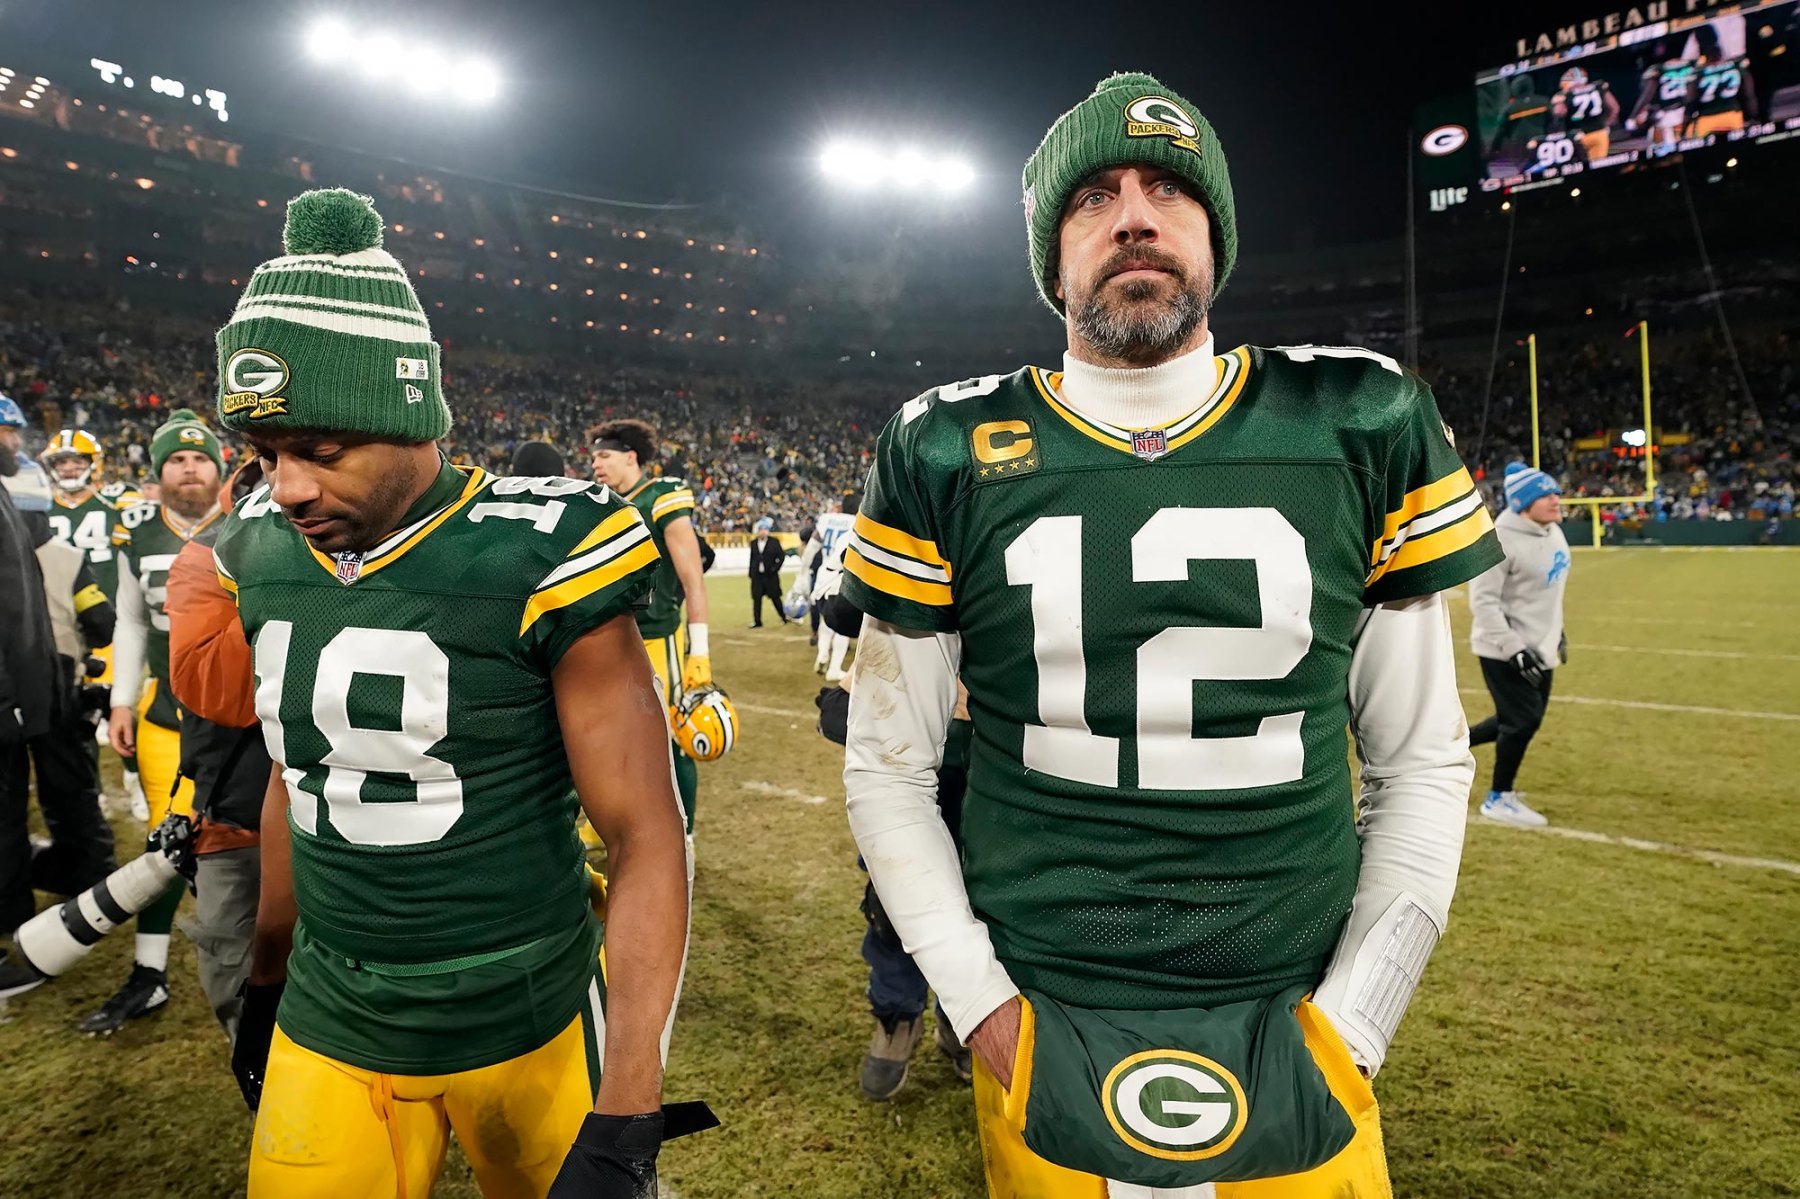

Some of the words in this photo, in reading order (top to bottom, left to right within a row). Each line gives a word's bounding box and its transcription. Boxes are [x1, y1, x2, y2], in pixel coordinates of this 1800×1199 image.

[1516, 1, 1668, 58] LAMBEAU
[1130, 124, 1179, 136] PACKERS
[1537, 139, 1574, 166] 90
[259, 400, 278, 413] NFC
[972, 420, 1033, 464] C
[1137, 439, 1162, 452] NFL
[340, 562, 356, 577] NFL
[1003, 506, 1314, 791] 12
[254, 619, 464, 846] 18
[1115, 1063, 1232, 1146] G
